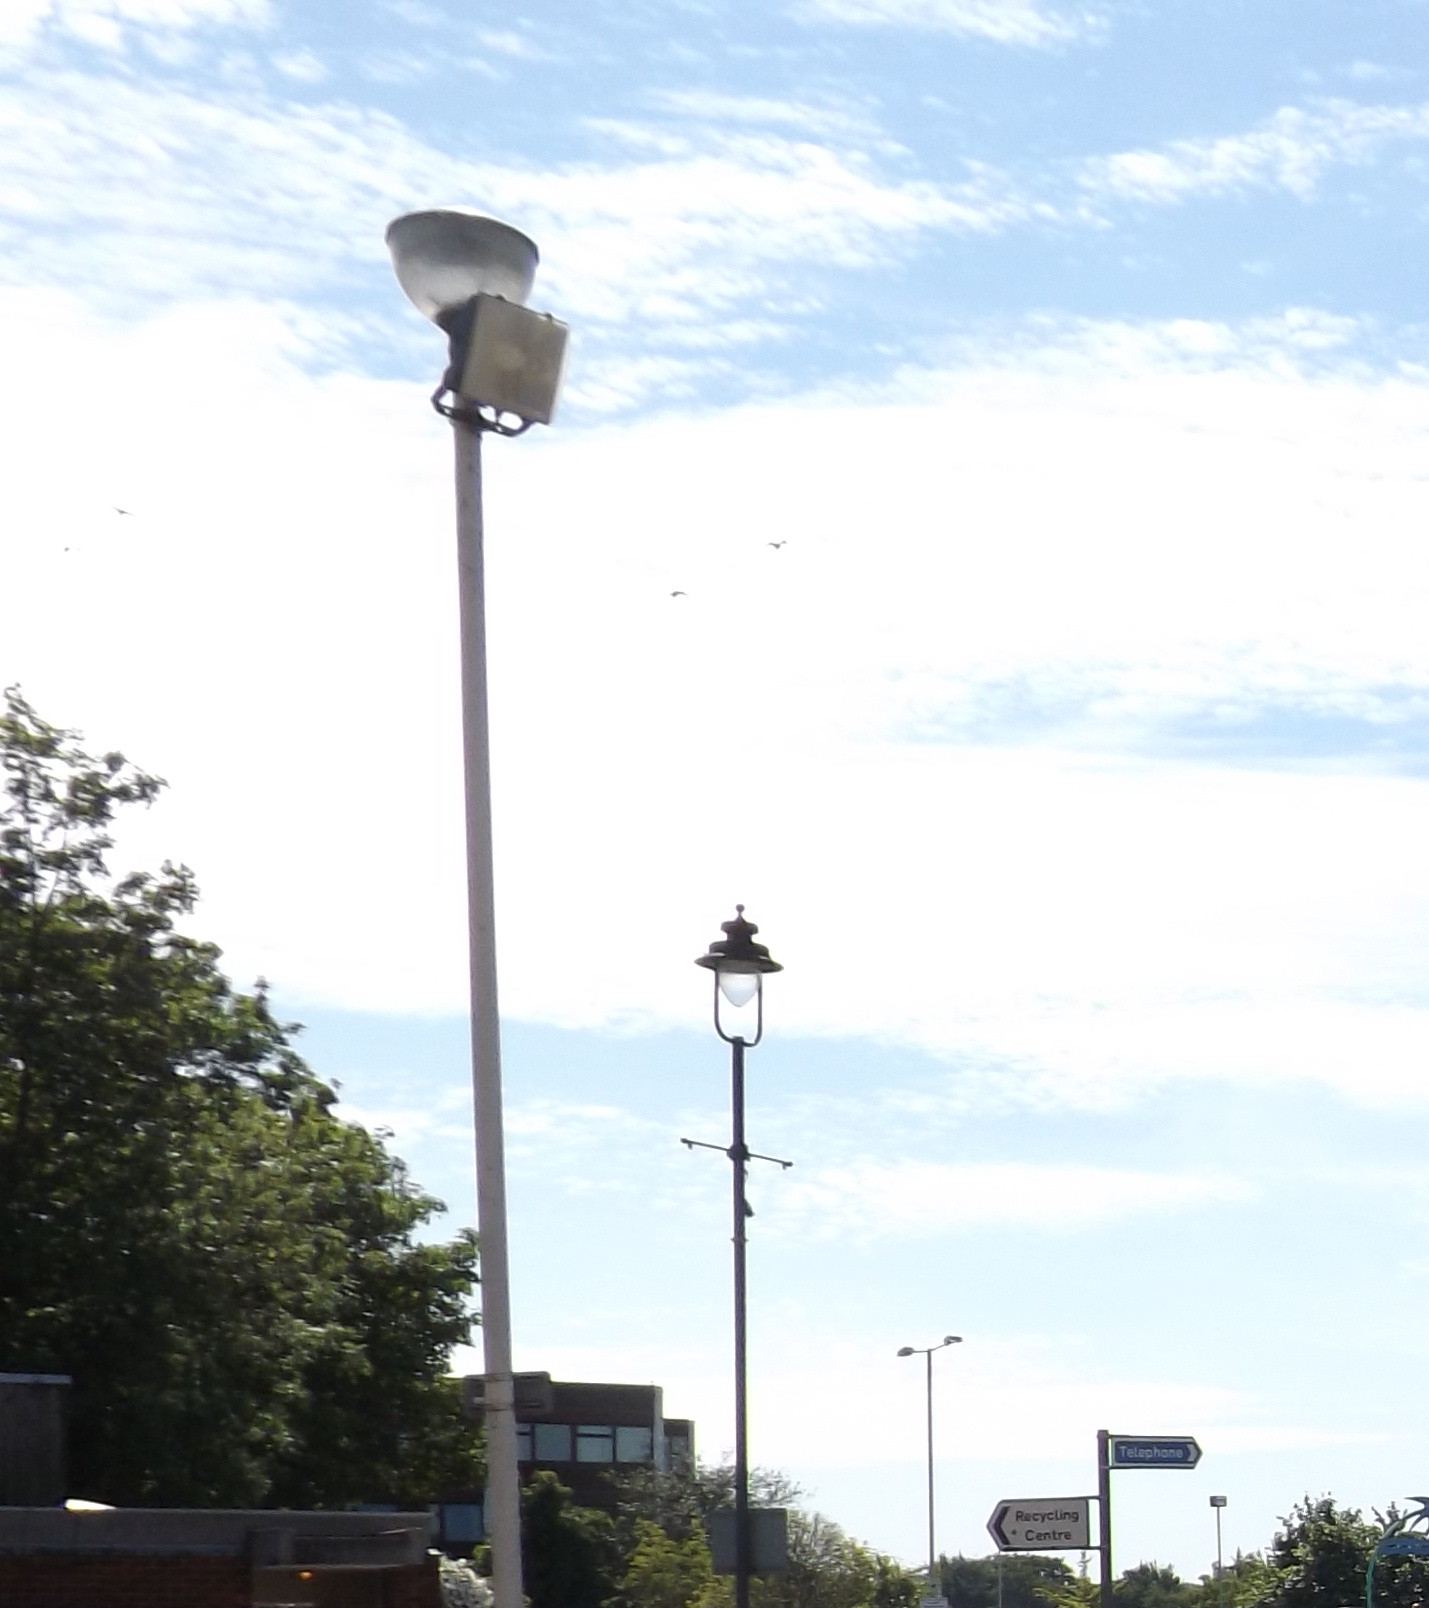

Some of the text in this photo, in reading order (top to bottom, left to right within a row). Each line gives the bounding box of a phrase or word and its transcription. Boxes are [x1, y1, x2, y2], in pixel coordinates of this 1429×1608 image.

[1119, 1445, 1184, 1460] Telephone
[1015, 1510, 1079, 1524] Recycling
[1025, 1529, 1072, 1541] Centre
